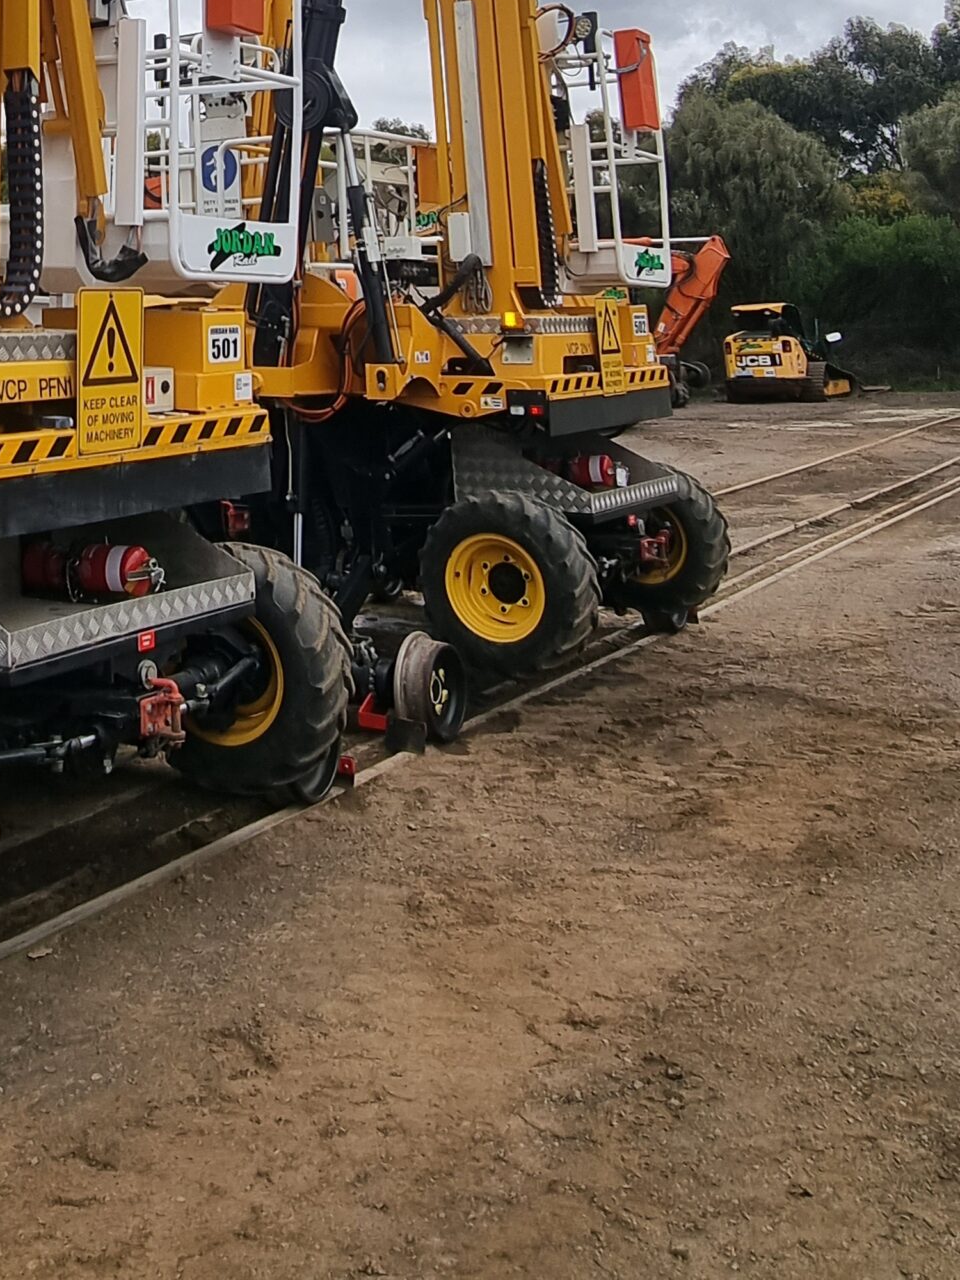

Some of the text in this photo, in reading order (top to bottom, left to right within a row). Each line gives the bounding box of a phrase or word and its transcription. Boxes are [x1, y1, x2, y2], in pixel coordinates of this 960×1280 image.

[214, 228, 274, 255] JORDAN
[233, 252, 257, 267] Rail
[211, 338, 238, 359] 501
[736, 355, 772, 367] JCB
[83, 395, 138, 410] KEEP CLEAR
[87, 412, 135, 427] OF MOVING
[86, 428, 135, 443] MACHINERY
